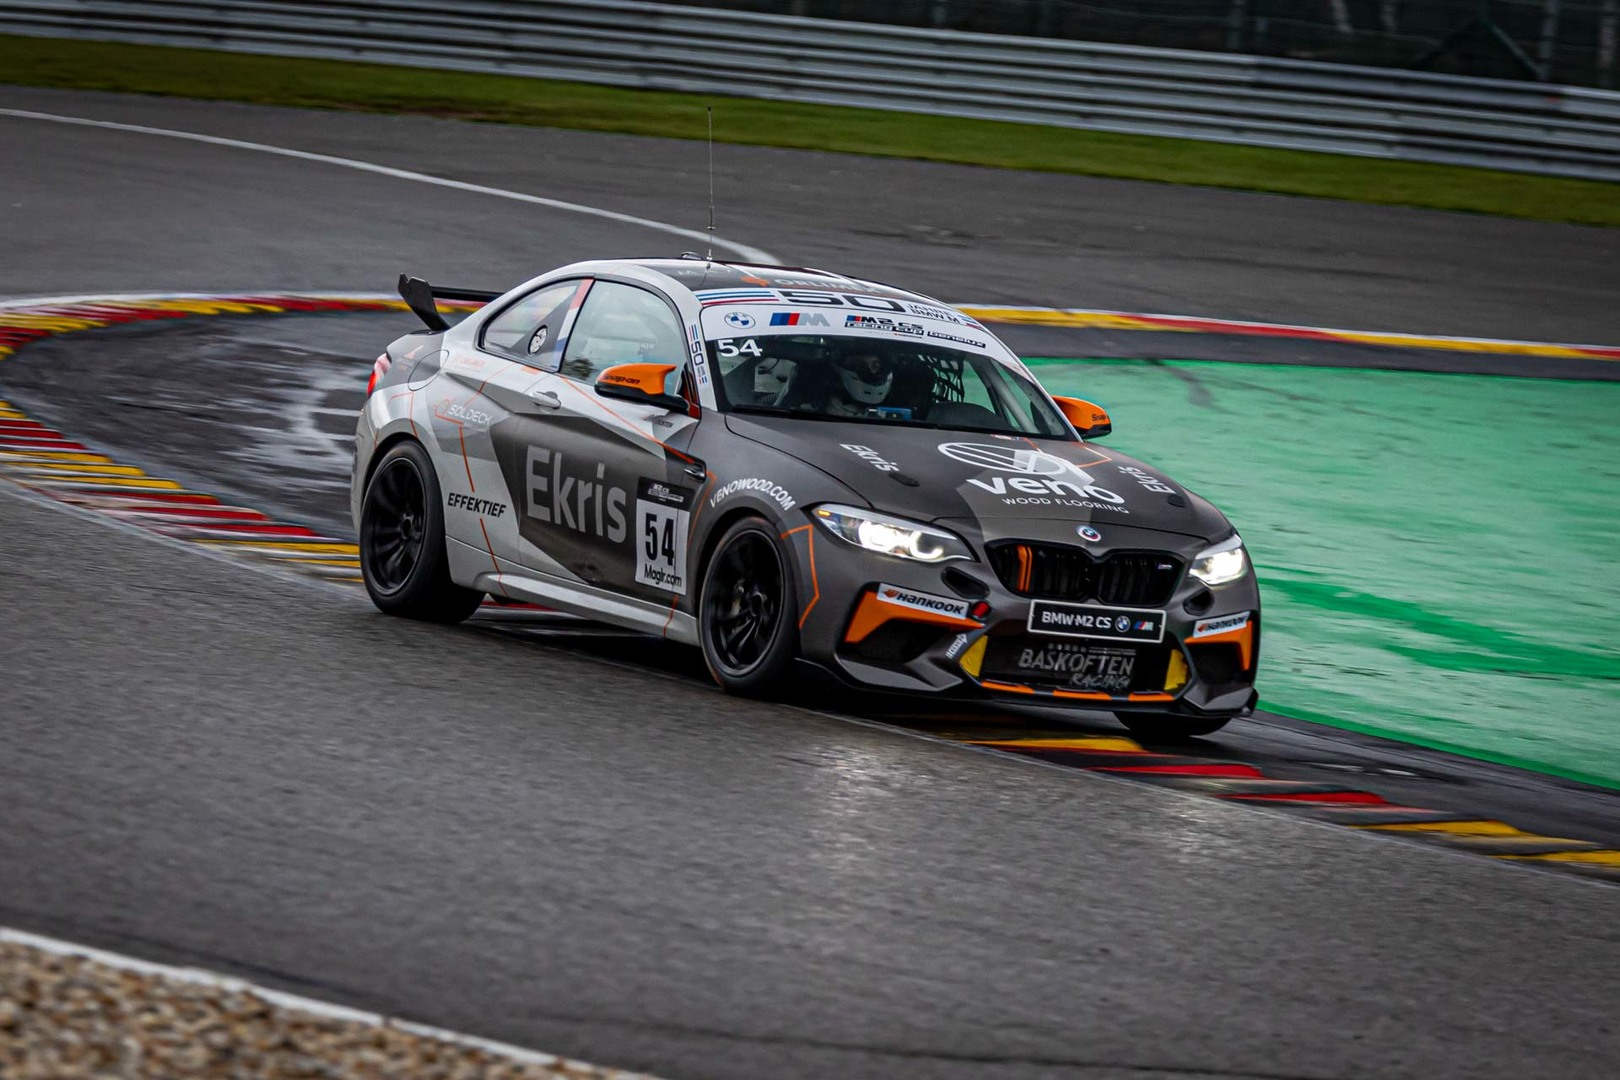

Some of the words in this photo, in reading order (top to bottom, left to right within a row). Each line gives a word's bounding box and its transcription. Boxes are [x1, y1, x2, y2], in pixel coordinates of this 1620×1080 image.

[778, 290, 906, 313] 50
[691, 340, 704, 366] 50
[718, 338, 763, 357] 54
[448, 404, 493, 425] SOLDECK
[839, 443, 900, 472] Ekris
[966, 477, 1125, 504] veno
[1117, 466, 1177, 494] Ekris
[447, 492, 507, 518] EFFEKTIEF
[526, 445, 627, 543] Ekris
[710, 478, 796, 511] VENOWOOD.COM
[1055, 499, 1130, 514] FLOORING
[645, 512, 674, 566] 54
[1041, 611, 1076, 626] BMW
[1075, 614, 1094, 627] M2
[1095, 616, 1113, 629] CS
[1018, 648, 1135, 676] BASKOFTEN
